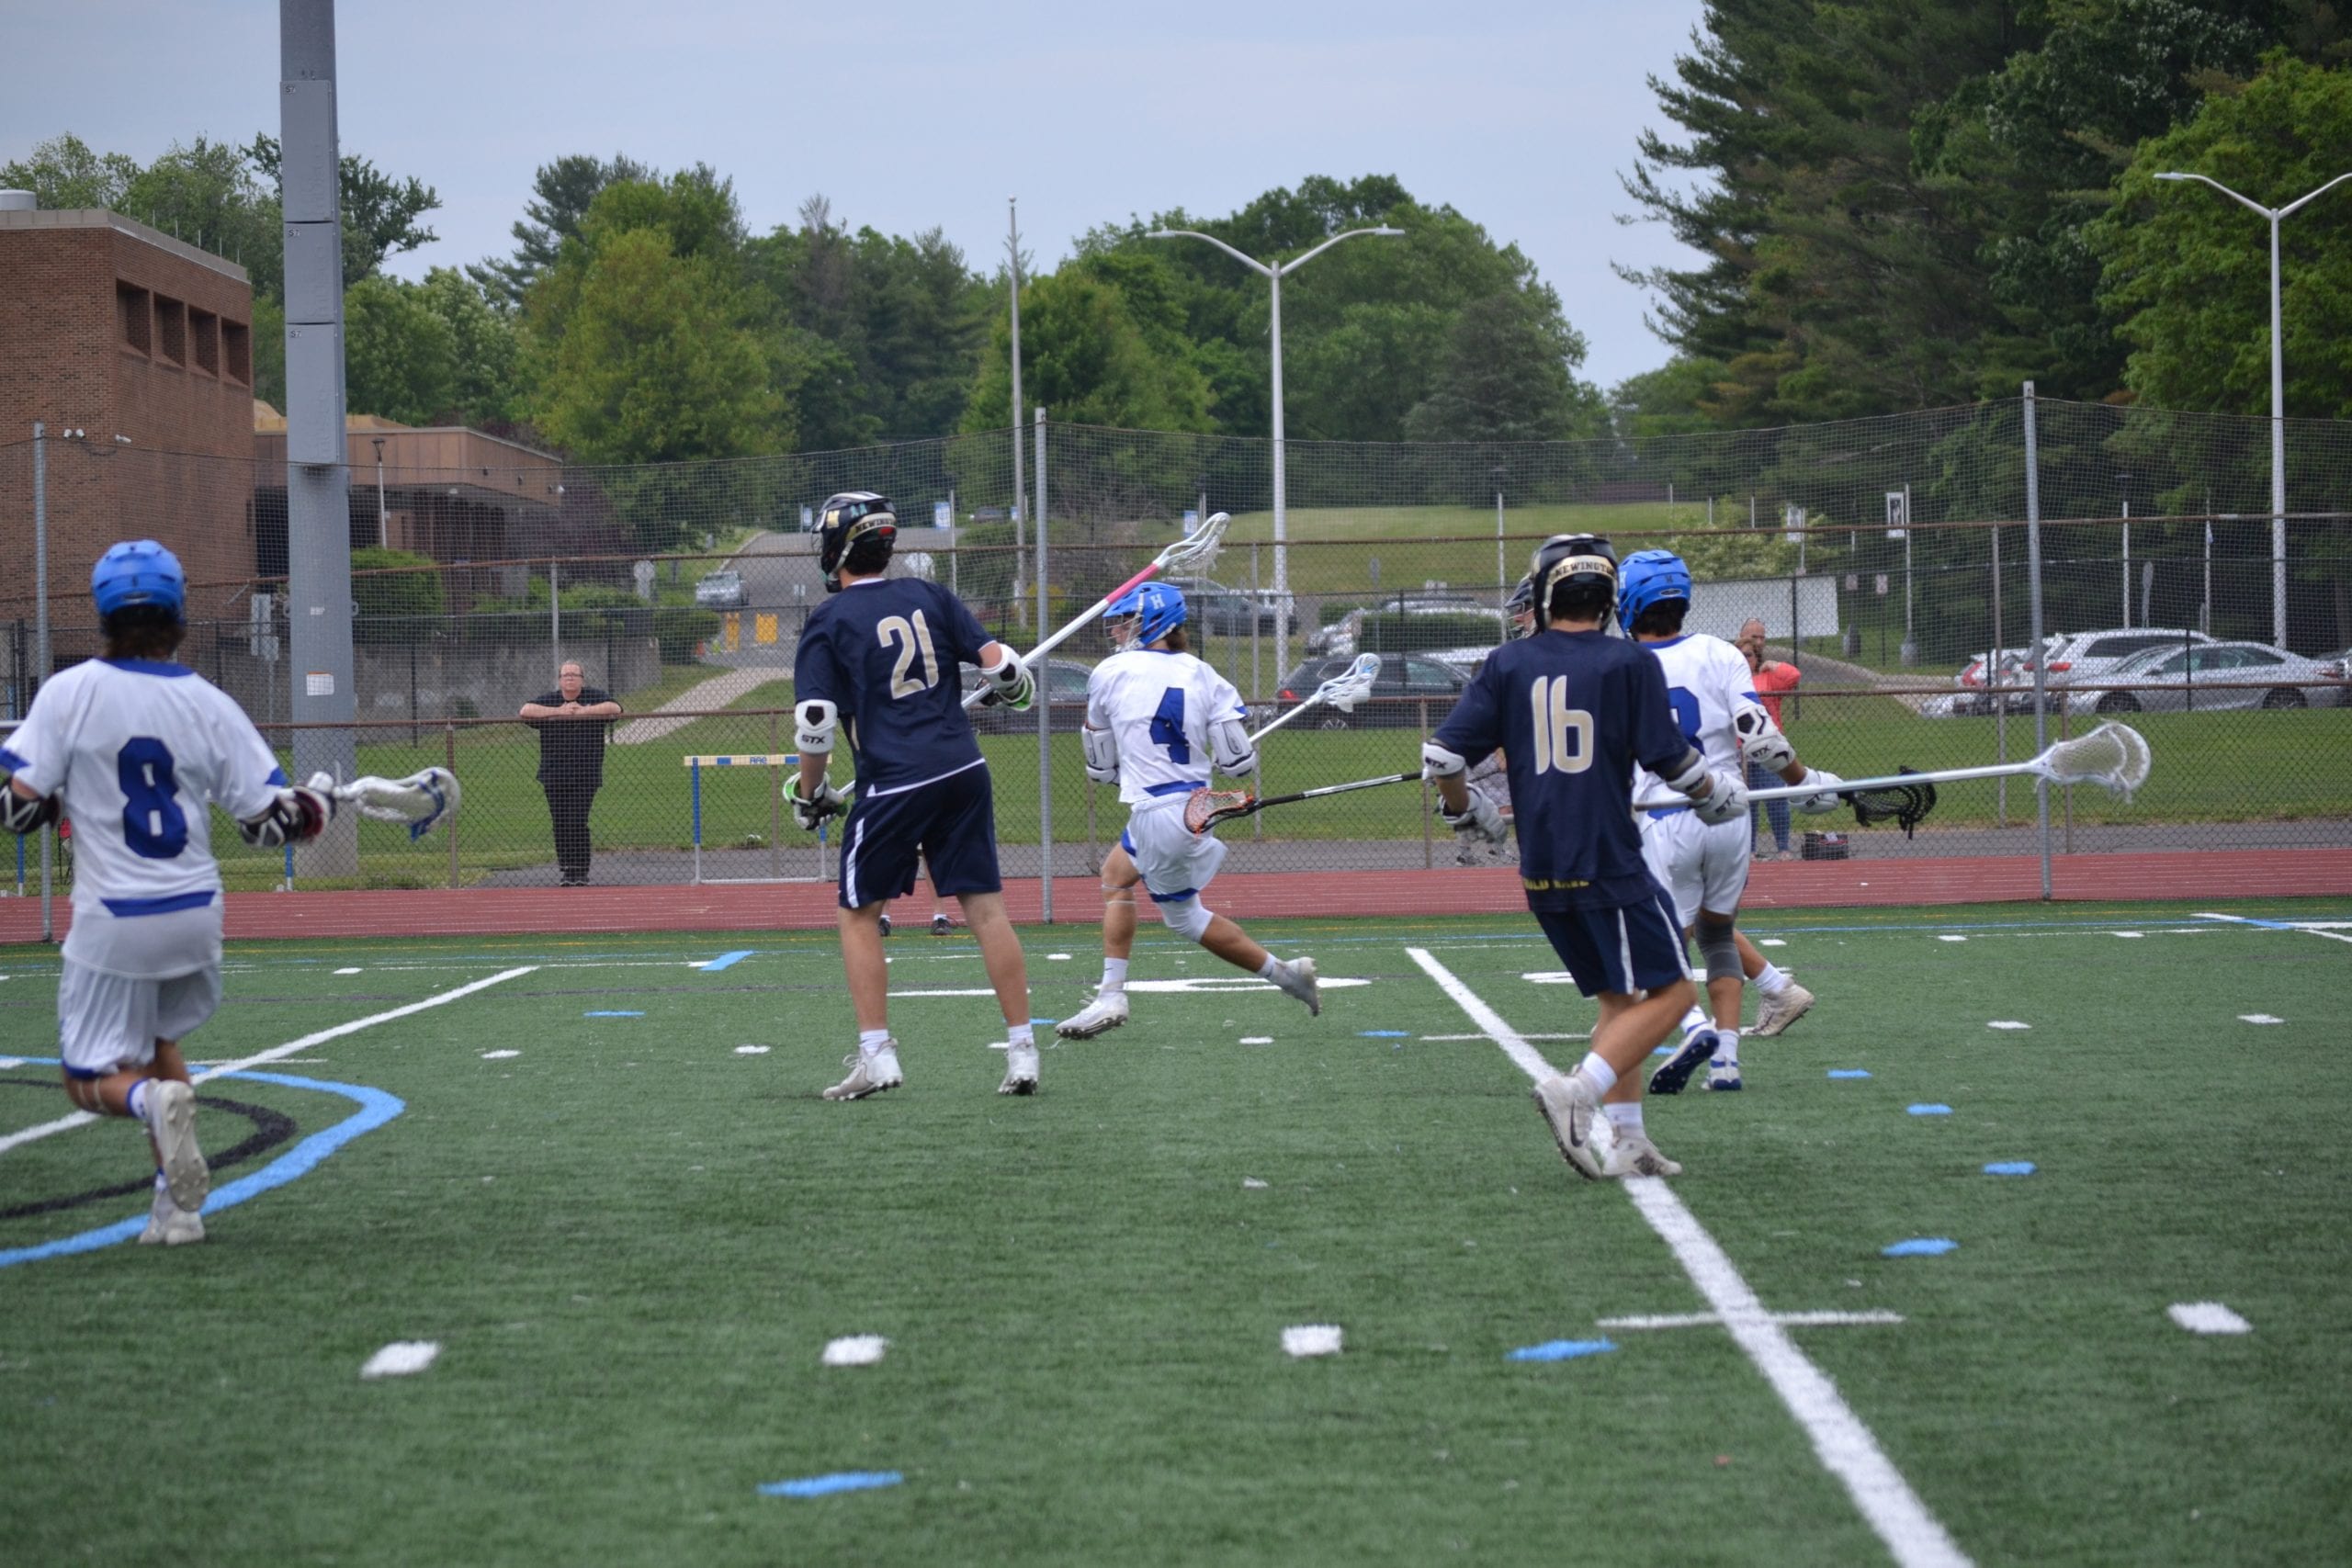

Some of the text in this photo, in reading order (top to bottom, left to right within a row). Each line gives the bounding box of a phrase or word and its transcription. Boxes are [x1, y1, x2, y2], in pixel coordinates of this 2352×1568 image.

[1150, 593, 1166, 610] H
[876, 609, 939, 700] 21
[801, 734, 826, 745] STX
[1149, 686, 1190, 765] 4
[1531, 674, 1594, 775] 16
[1751, 744, 1771, 759] STX
[119, 737, 188, 859] 8
[1805, 793, 1822, 808] ST
